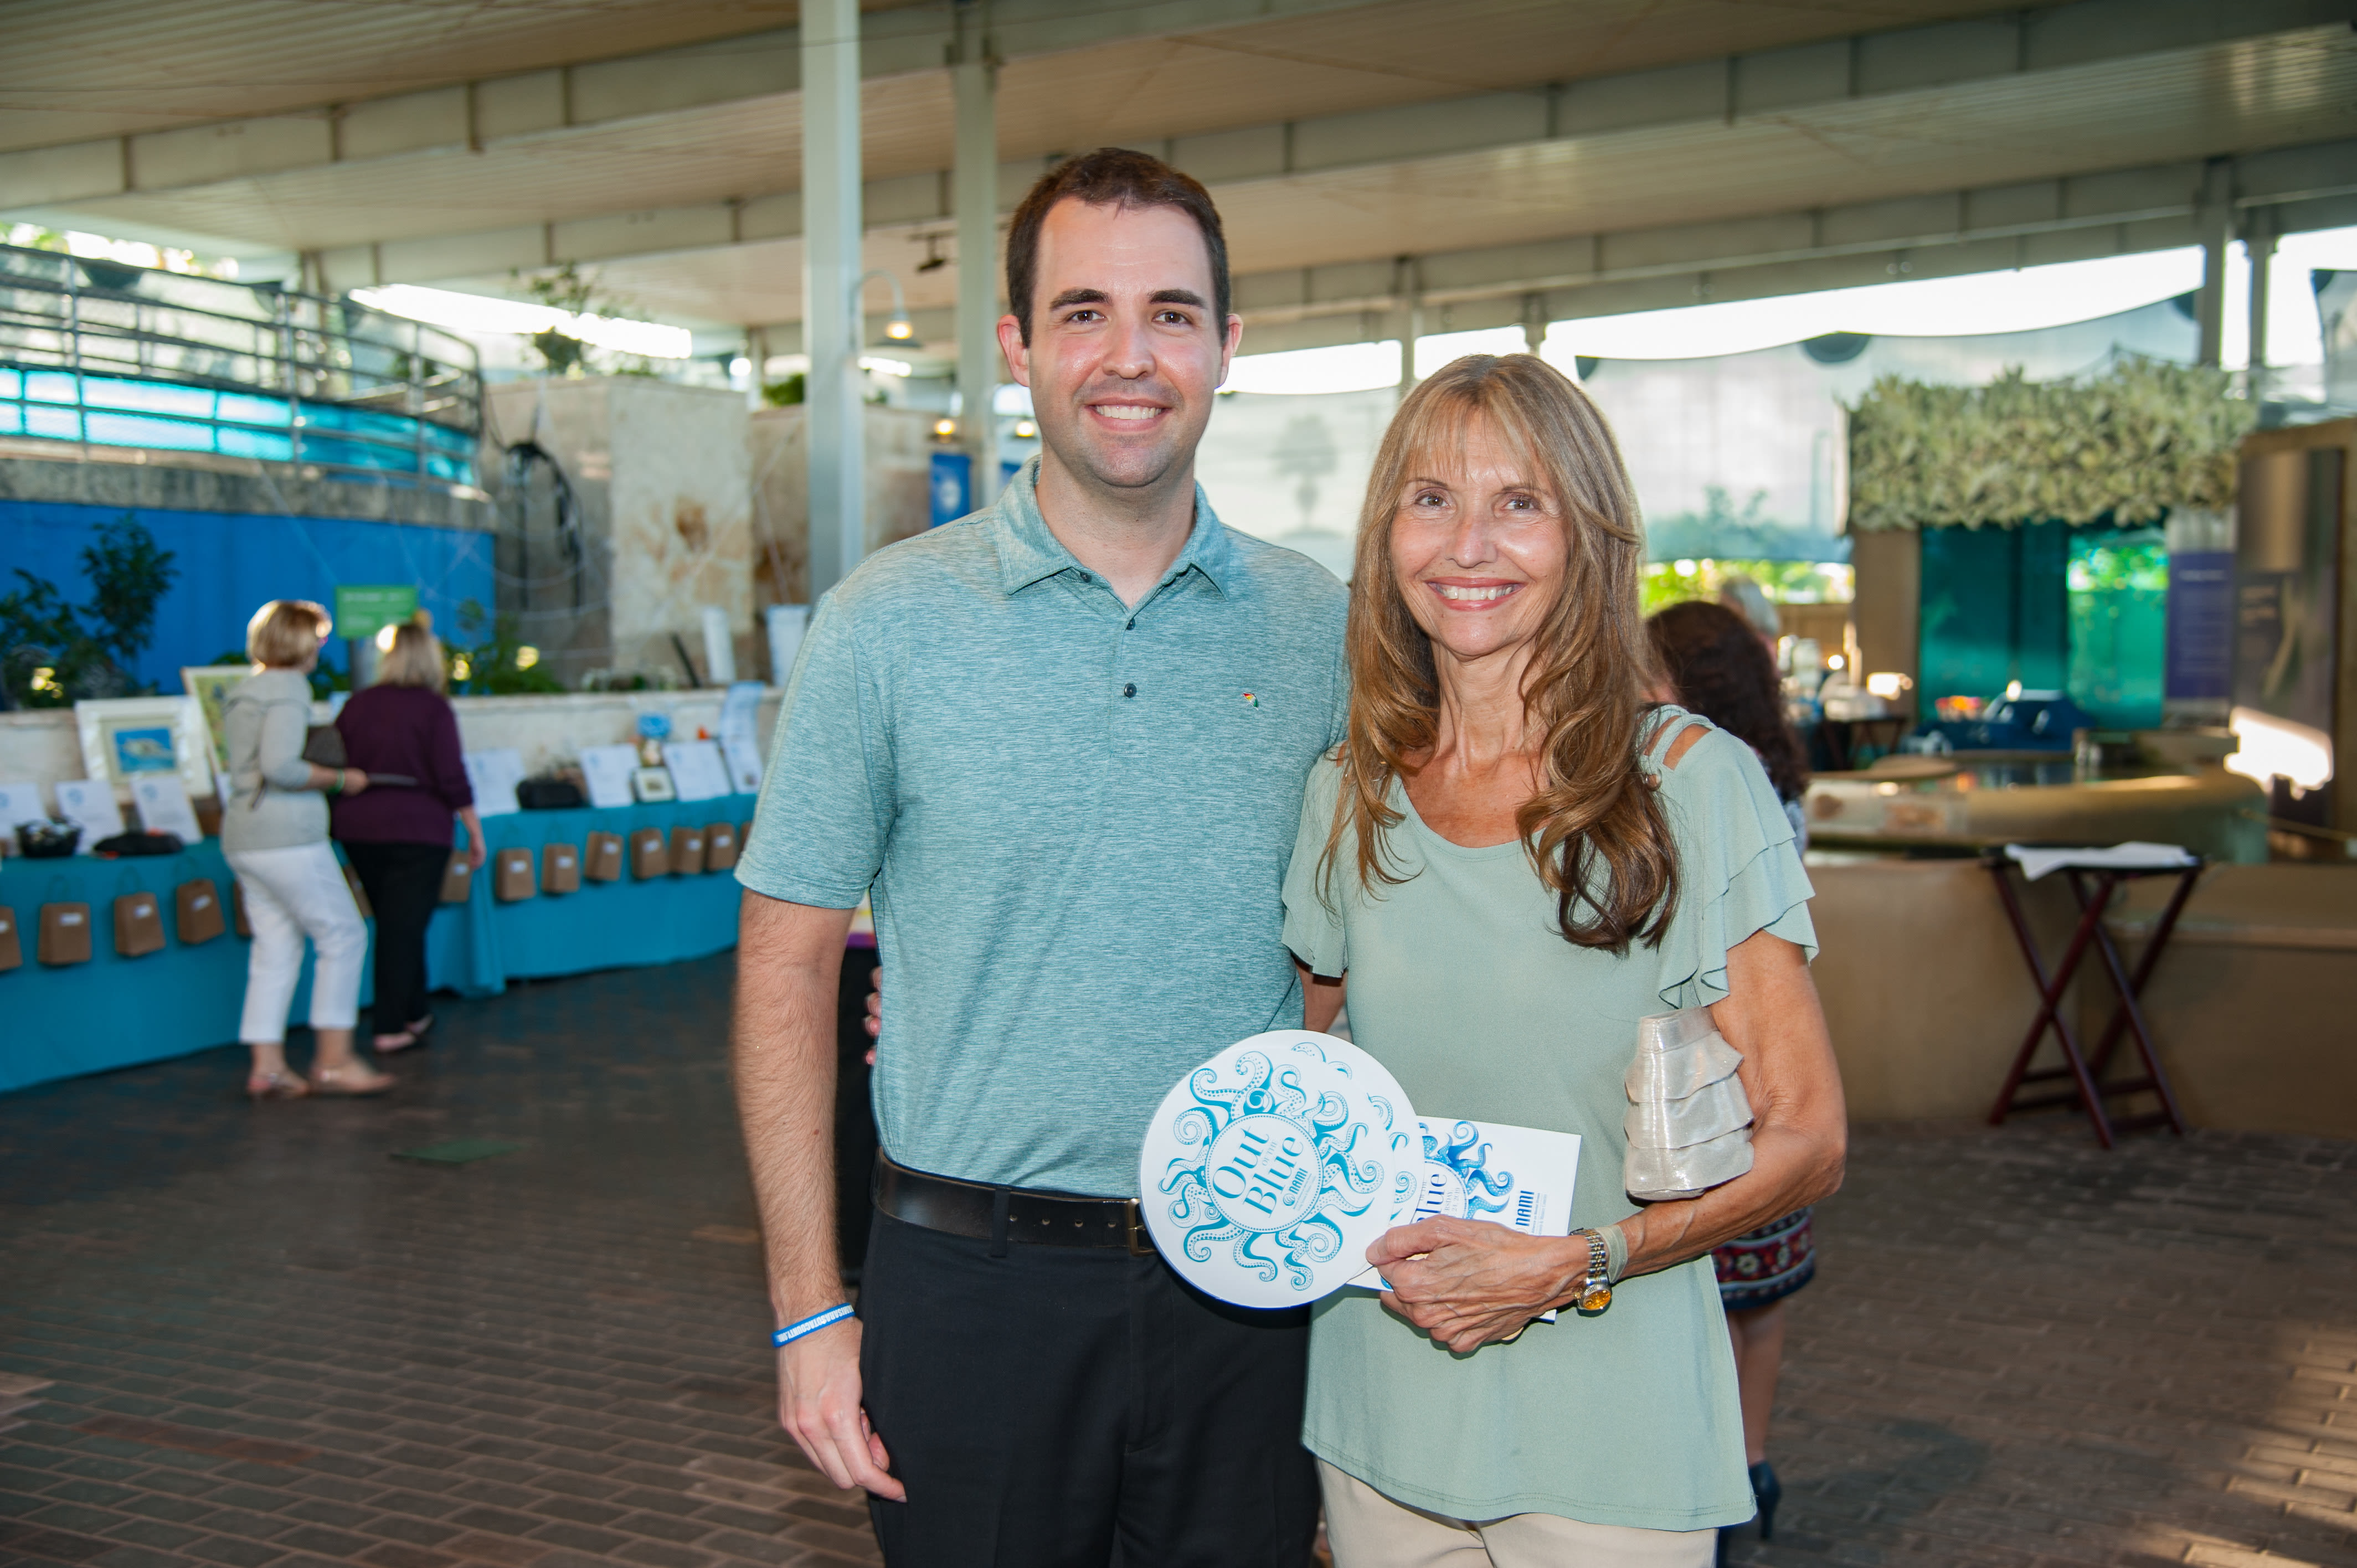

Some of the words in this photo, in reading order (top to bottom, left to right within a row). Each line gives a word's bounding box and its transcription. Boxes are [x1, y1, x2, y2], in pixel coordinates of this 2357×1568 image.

[1213, 1126, 1269, 1199] Out
[1262, 1157, 1270, 1166] OF
[1267, 1142, 1277, 1155] THE
[1243, 1137, 1304, 1218] Blue
[1289, 1168, 1308, 1194] NAMI
[1416, 1174, 1447, 1221] lue
[1515, 1190, 1534, 1226] NAMI
